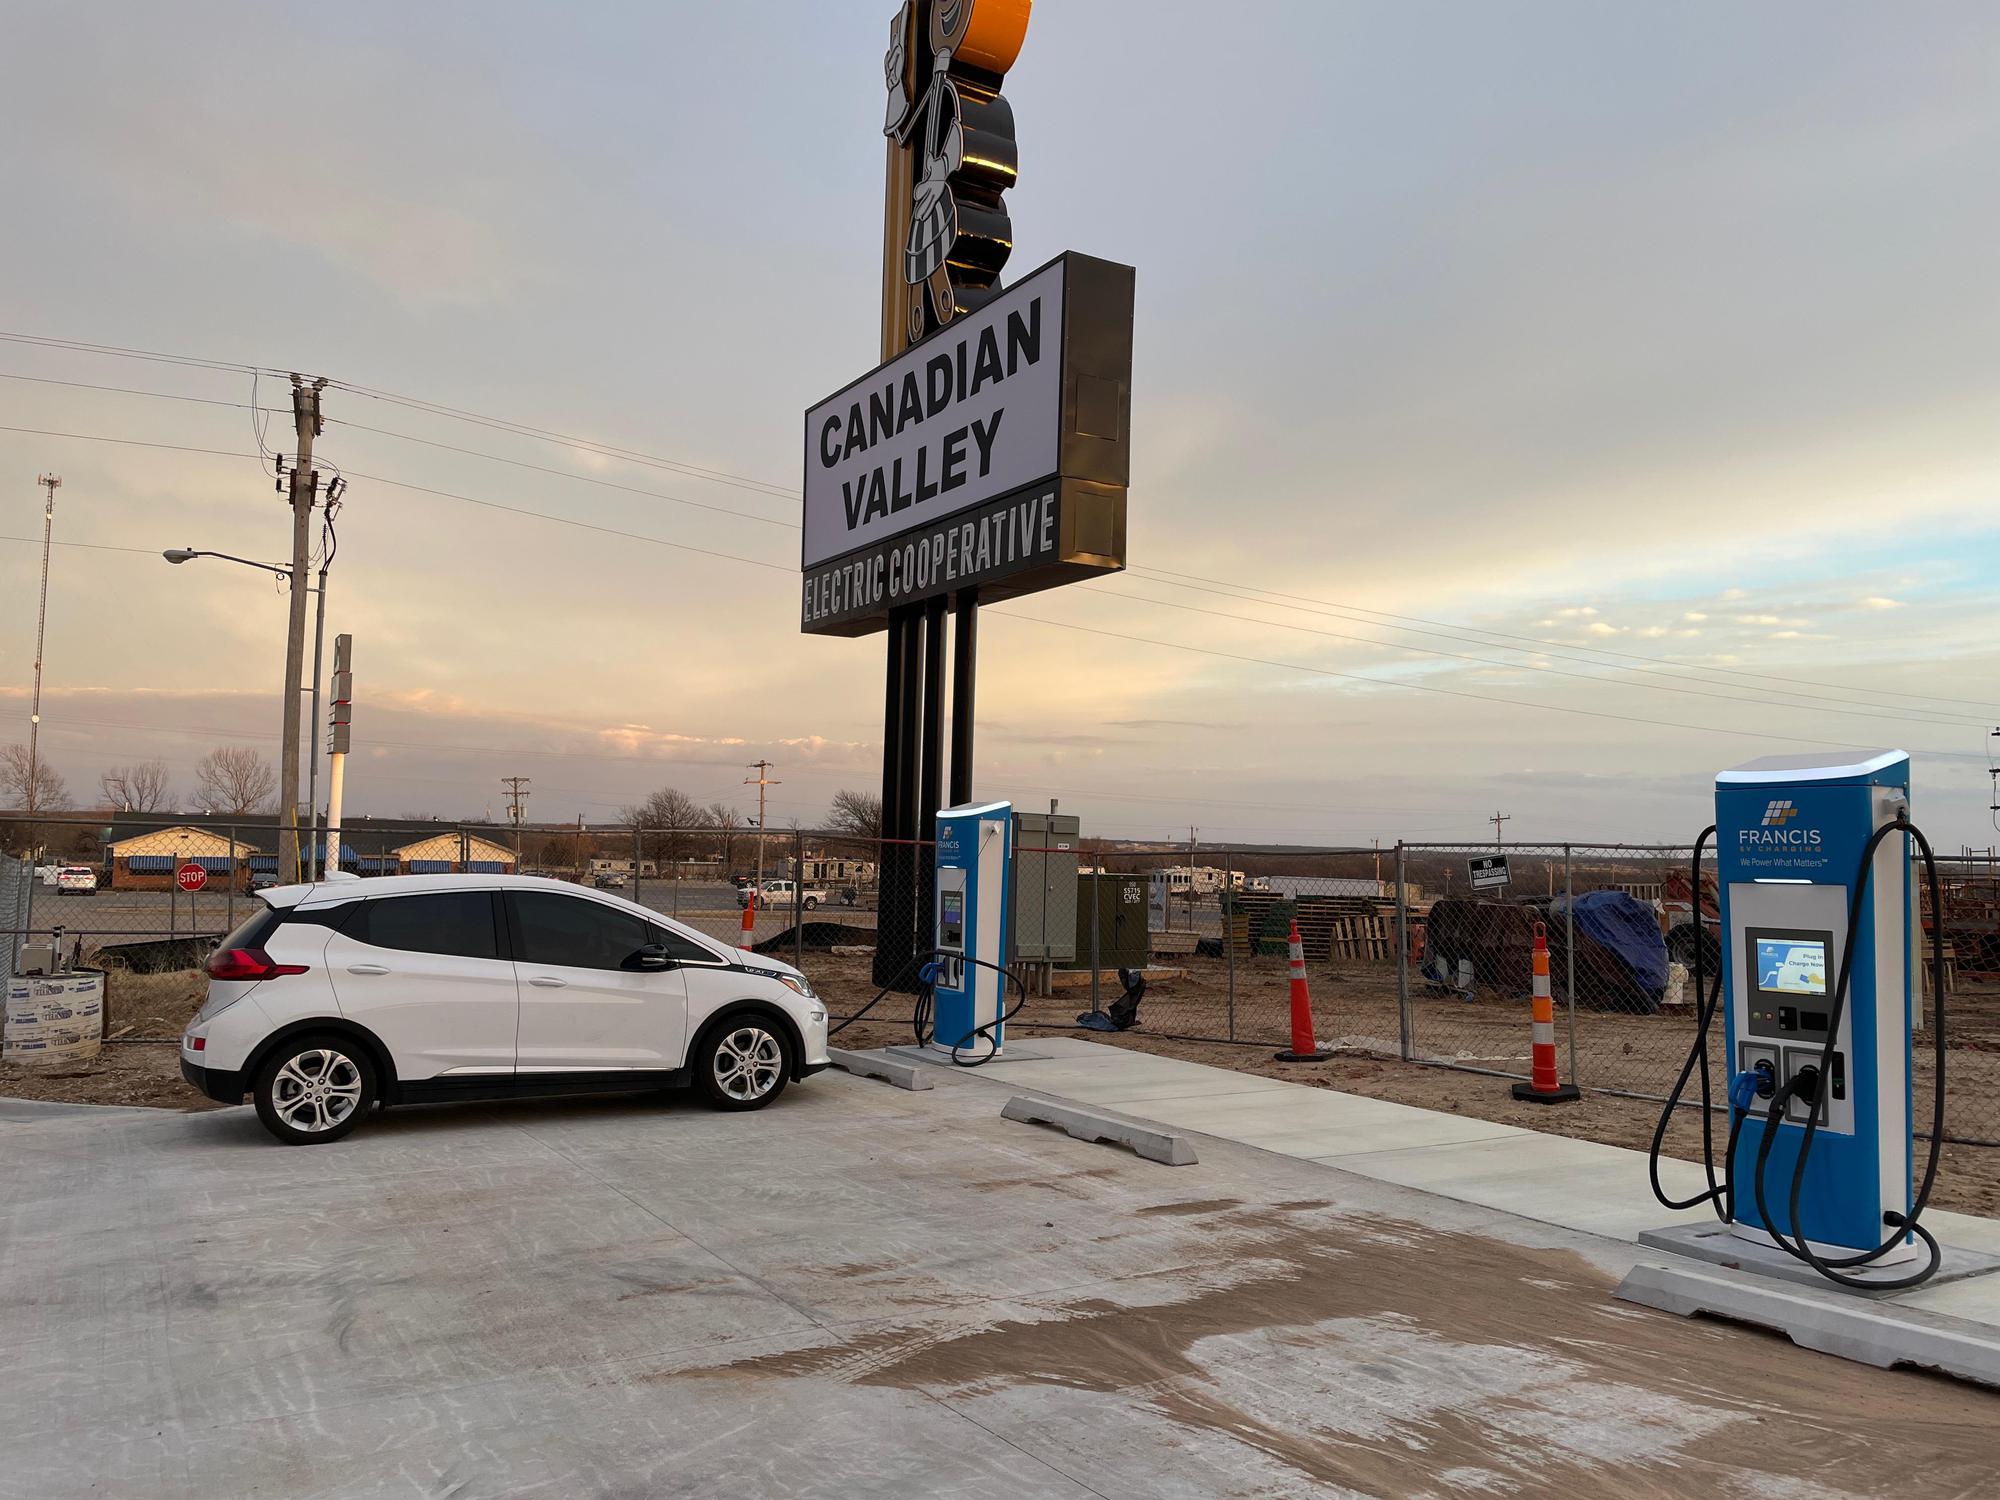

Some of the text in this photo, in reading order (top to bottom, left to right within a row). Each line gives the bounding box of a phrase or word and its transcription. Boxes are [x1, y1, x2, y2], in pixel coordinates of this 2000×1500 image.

[820, 296, 1041, 469] CANADIAN
[842, 407, 1005, 531] VALLEY
[804, 492, 1055, 623] ELECTRIC COOPERATIVE
[1739, 829, 1822, 845] FRANCIS
[1758, 845, 1822, 853] CHARGING
[1482, 859, 1493, 869] NO
[1740, 858, 1751, 867] We
[1751, 858, 1772, 867] Power
[1773, 858, 1793, 867] What
[179, 871, 205, 883] STOP
[1472, 866, 1507, 879] TRESPASSING
[1803, 953, 1817, 961] Plug
[1788, 960, 1810, 968] Charge
